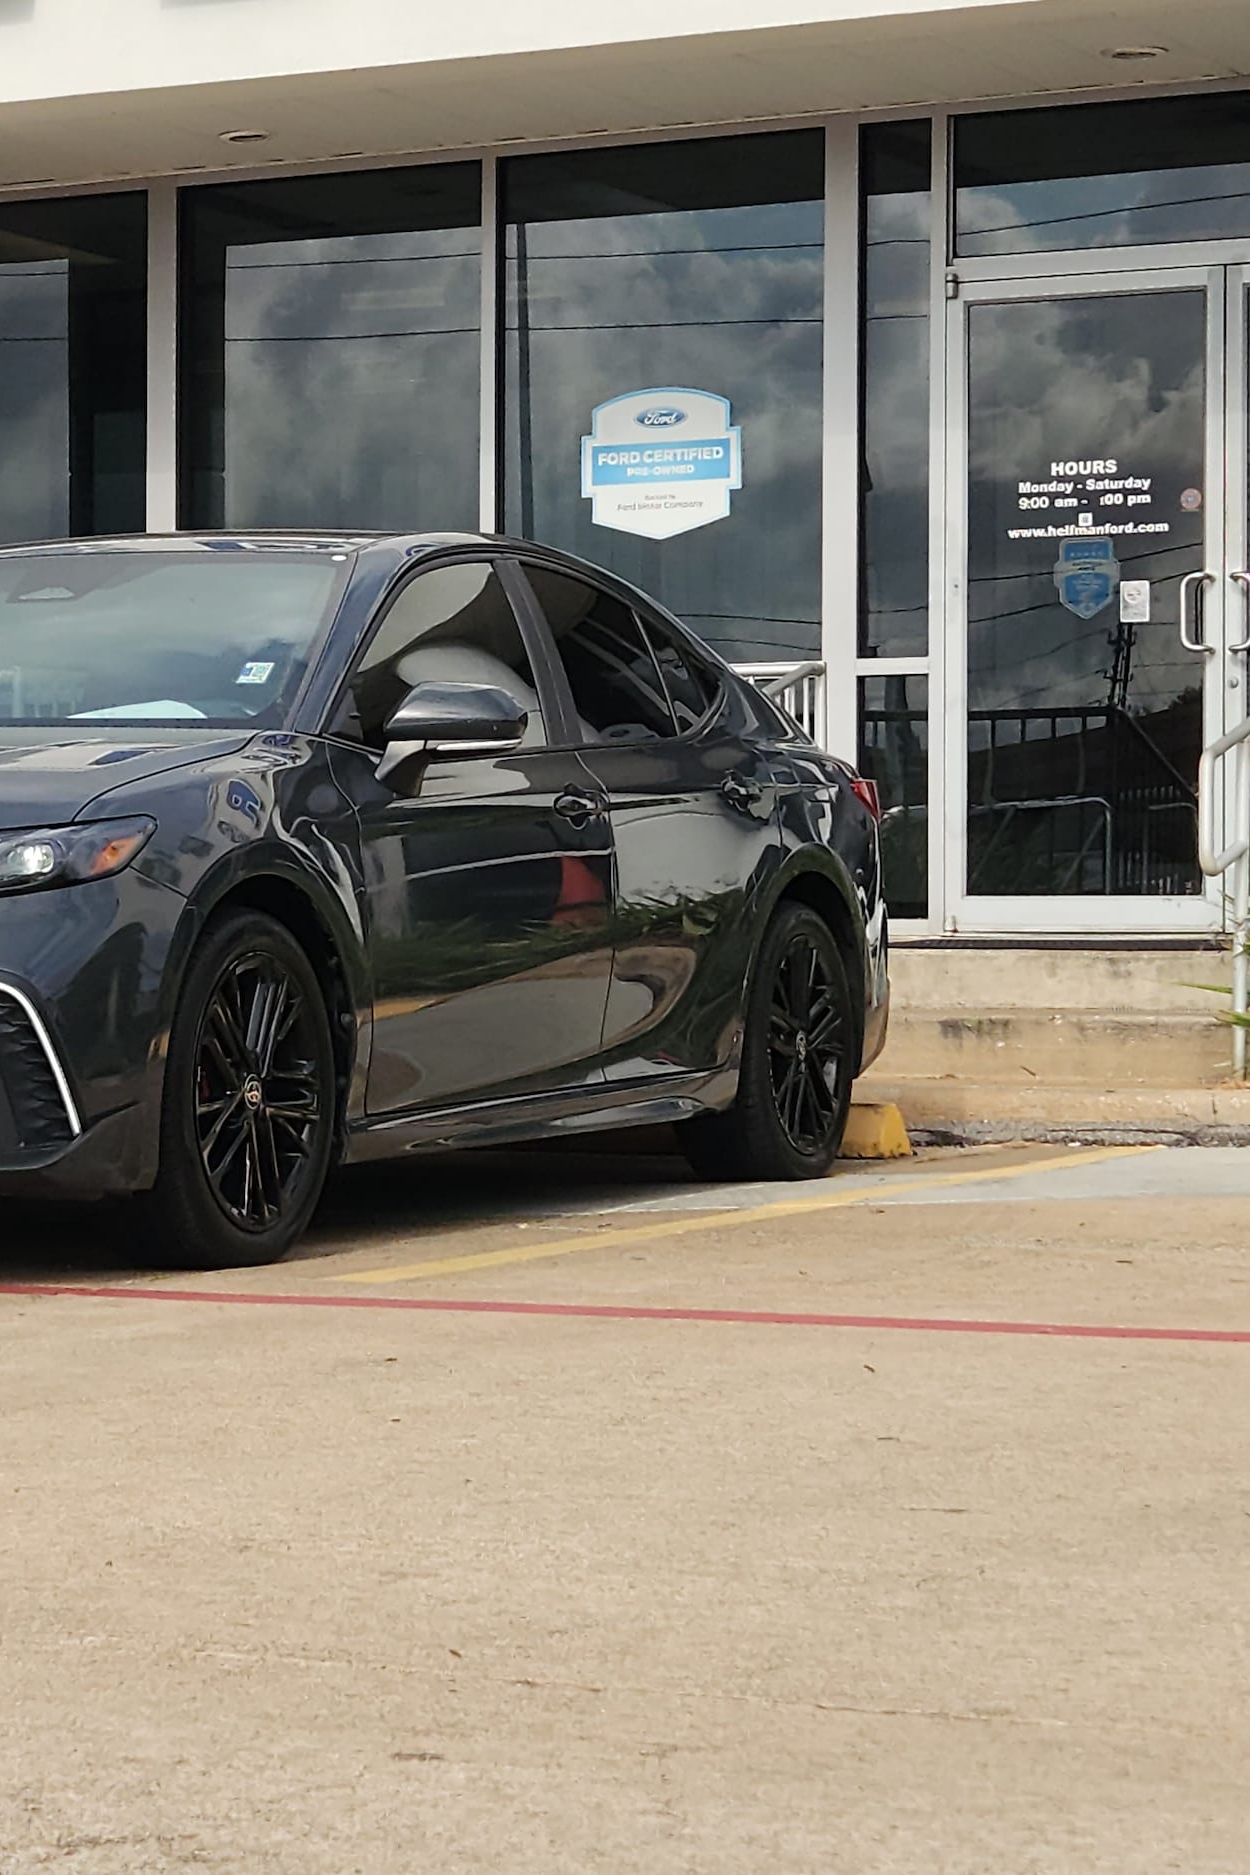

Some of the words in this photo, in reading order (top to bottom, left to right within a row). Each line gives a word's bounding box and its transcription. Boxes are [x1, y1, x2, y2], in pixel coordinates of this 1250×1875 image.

[643, 409, 677, 425] Ford
[598, 452, 640, 466] FORD
[643, 447, 723, 462] CERTIFIED
[626, 465, 694, 476] PRE-OWNED
[1050, 460, 1117, 476] HOURS
[1018, 480, 1074, 494] Monday
[1085, 476, 1151, 491] Saturday
[1018, 496, 1049, 510] 9:00
[1054, 497, 1078, 508] am
[1127, 494, 1152, 507] pm
